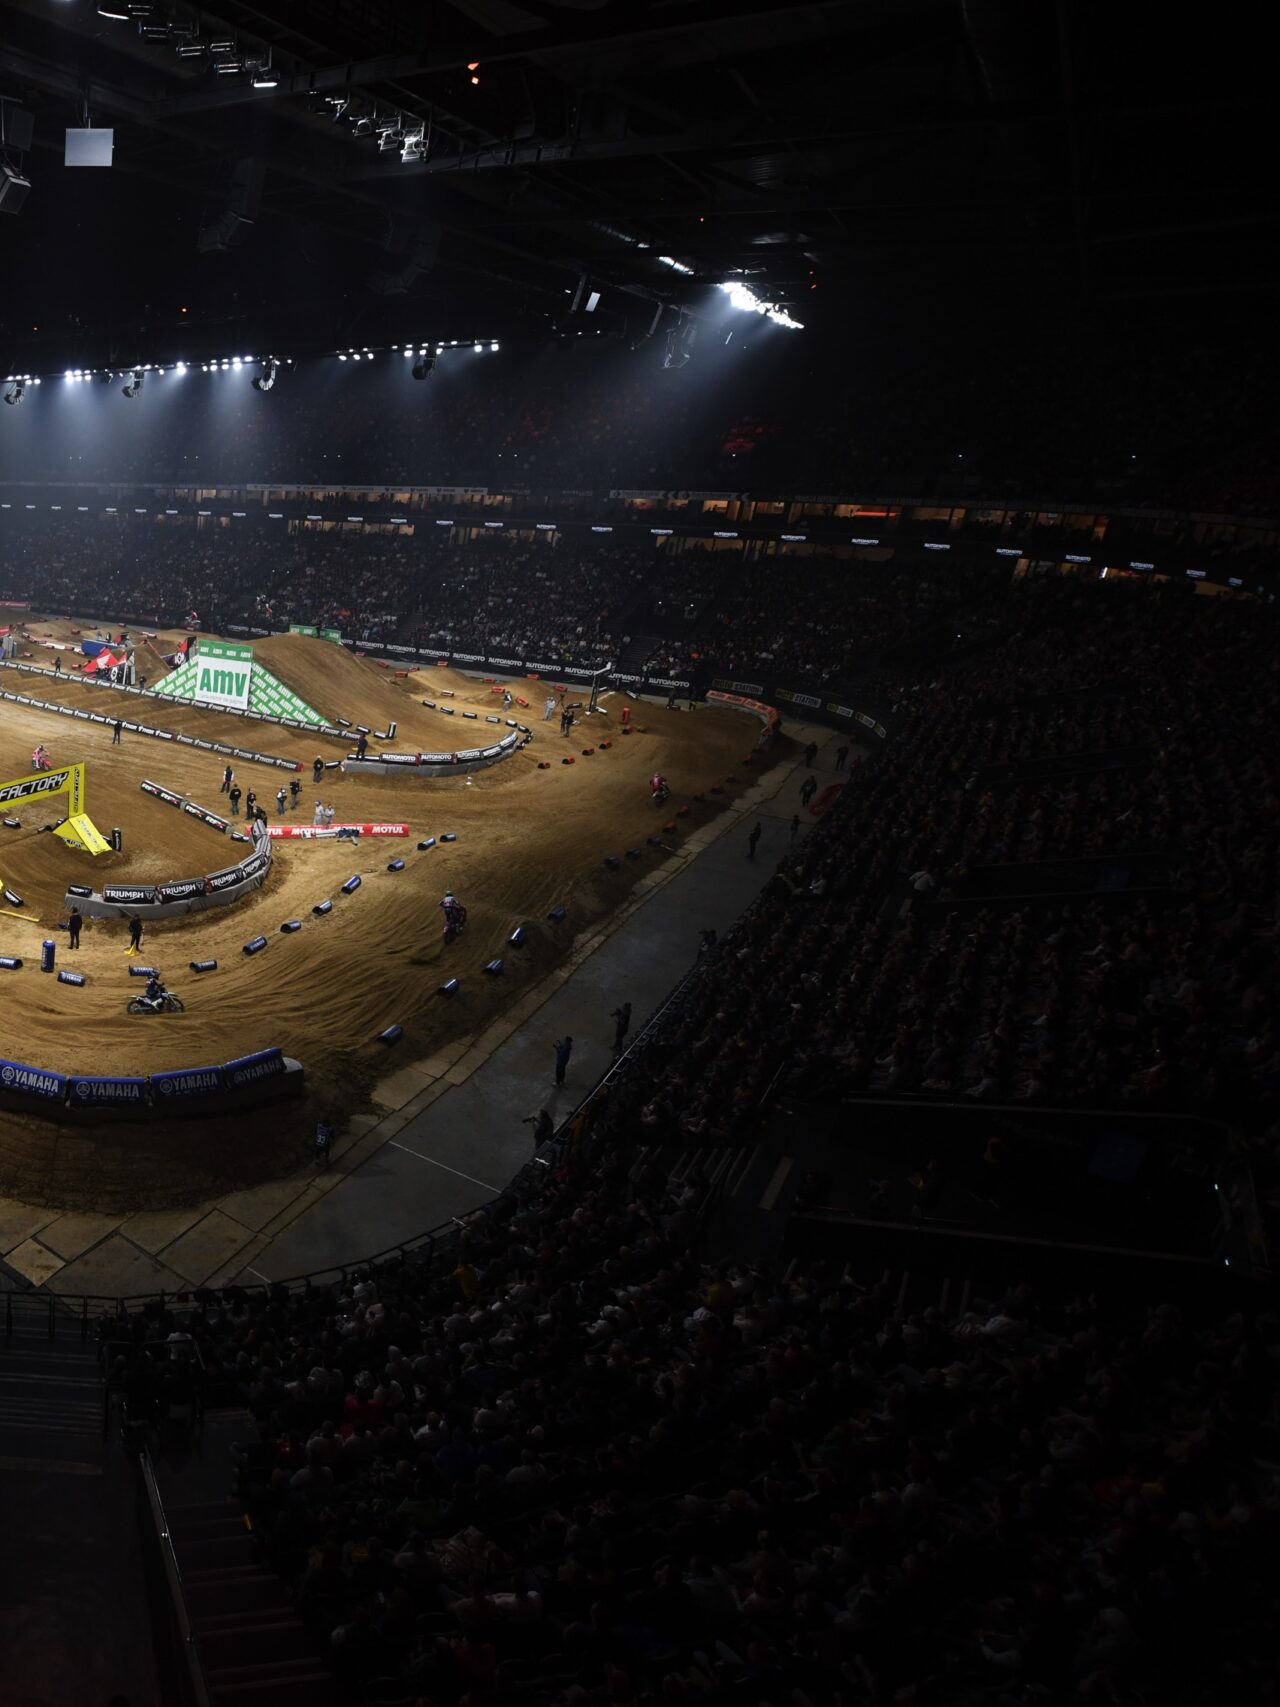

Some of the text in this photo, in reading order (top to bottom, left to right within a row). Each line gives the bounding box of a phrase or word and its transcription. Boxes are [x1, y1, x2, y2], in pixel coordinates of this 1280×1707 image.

[386, 643, 417, 653] AUTOMOTO
[419, 648, 451, 657] AUTOMOTO
[452, 652, 486, 662] AUTOMOTO
[488, 657, 523, 666] AUTOMOTO
[525, 662, 562, 671] AUTOMOTO
[565, 666, 598, 676] AUTOMOT
[648, 677, 690, 688] AUTOMOTO
[735, 682, 761, 694] STATION
[795, 695, 819, 708] STATION
[382, 754, 416, 762] AUTOMOTO
[371, 826, 404, 834] MOTUL
[244, 858, 261, 874] TRIUMPH
[210, 873, 236, 887] TRIUMPH
[105, 890, 144, 900] TRIUMPH
[161, 883, 196, 896] TRIUMPH
[244, 1059, 283, 1081] YAMAHA
[14, 1068, 60, 1093] YAMAHA
[173, 1073, 219, 1091] YAMAHA
[90, 1083, 140, 1098] YAMAHA
